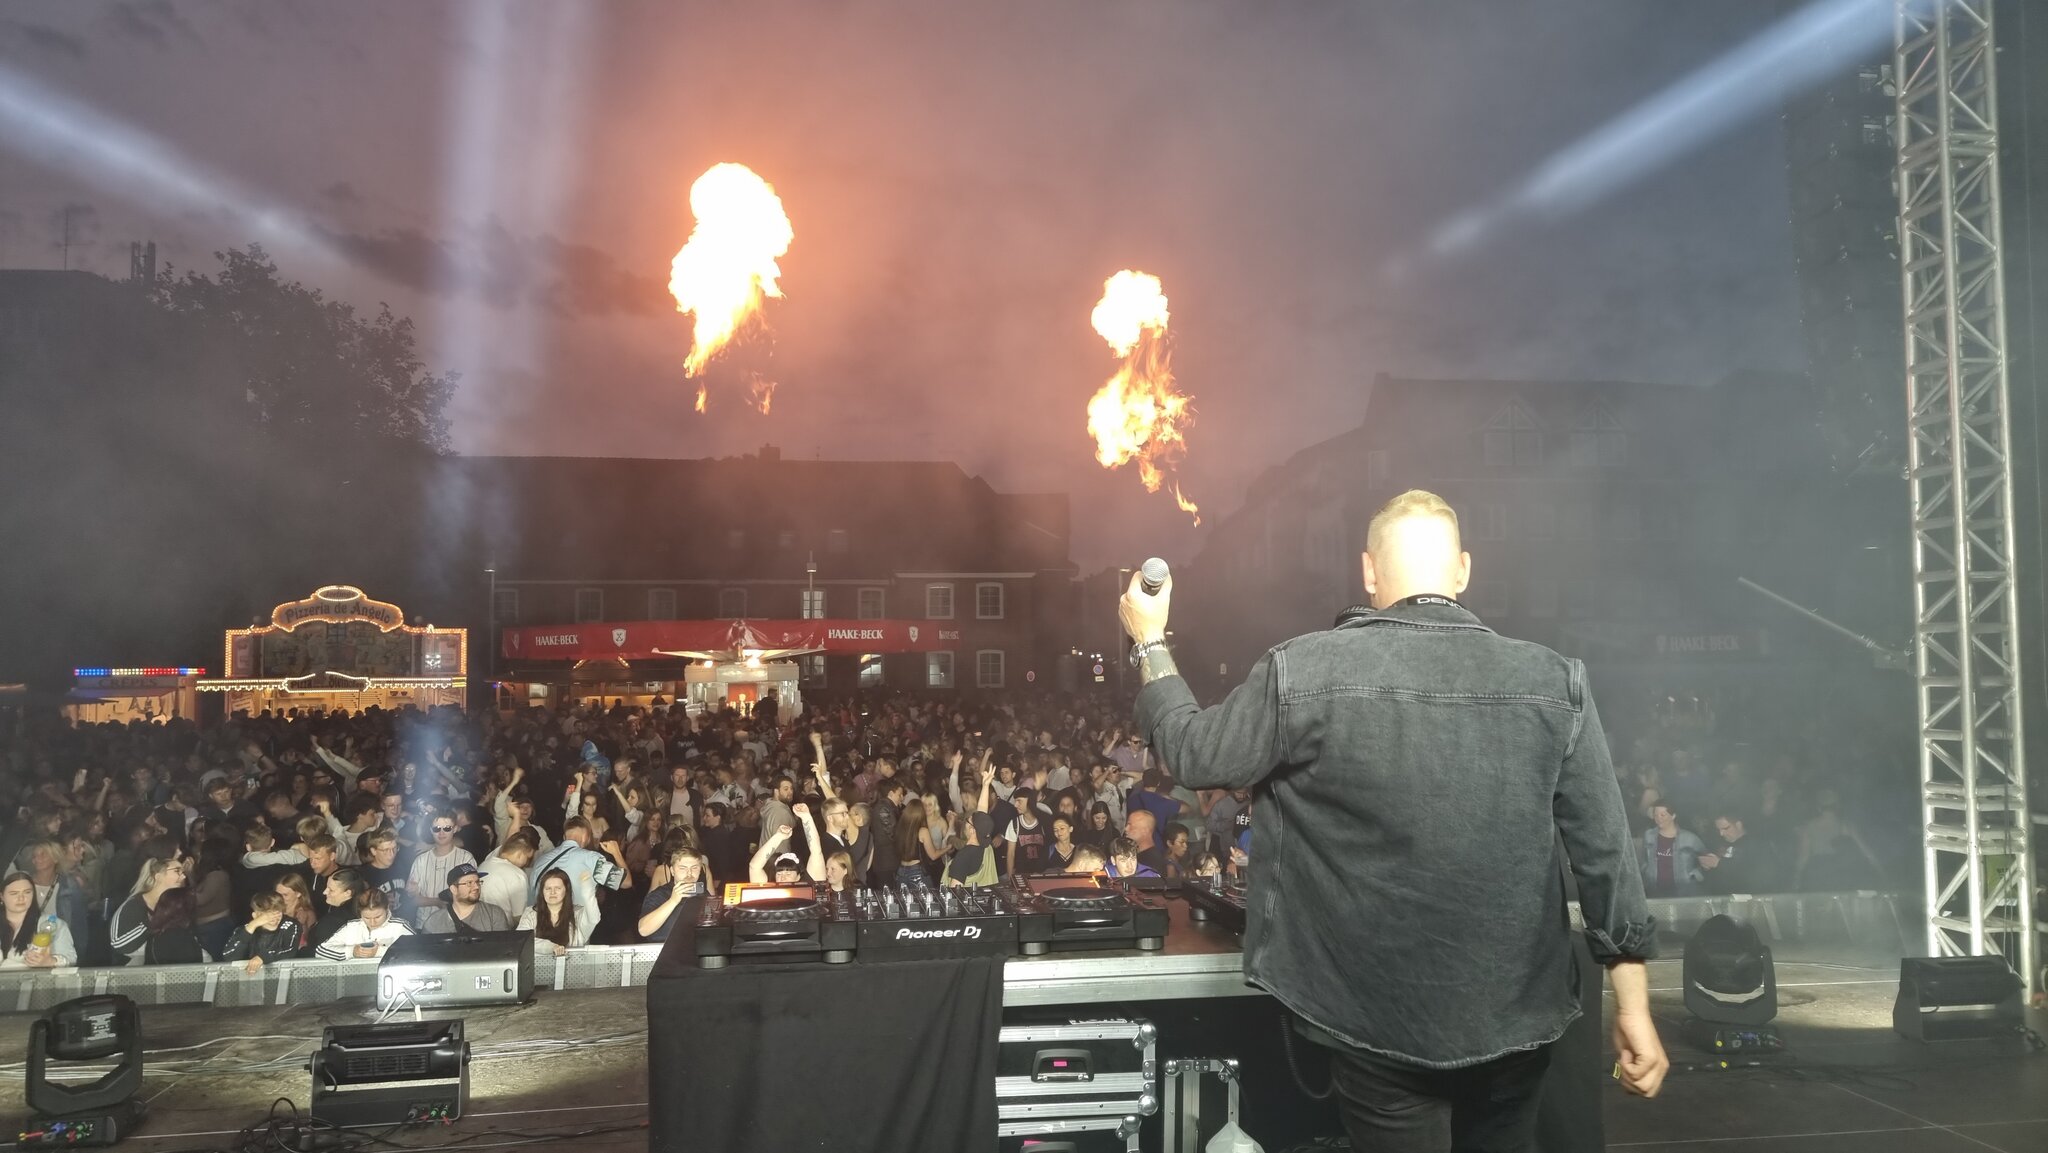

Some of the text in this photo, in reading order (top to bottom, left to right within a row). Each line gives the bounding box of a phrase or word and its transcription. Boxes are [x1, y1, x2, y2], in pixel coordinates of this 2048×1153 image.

[1417, 597, 1464, 610] DENO
[285, 602, 391, 623] Pizzeria de Angelo
[535, 634, 579, 646] HAAKE-BECK
[828, 629, 884, 640] HAAKE-BECK
[1669, 635, 1741, 652] HAAKE-BECK
[1236, 813, 1251, 826] DÉF
[895, 928, 961, 940] Pioneer
